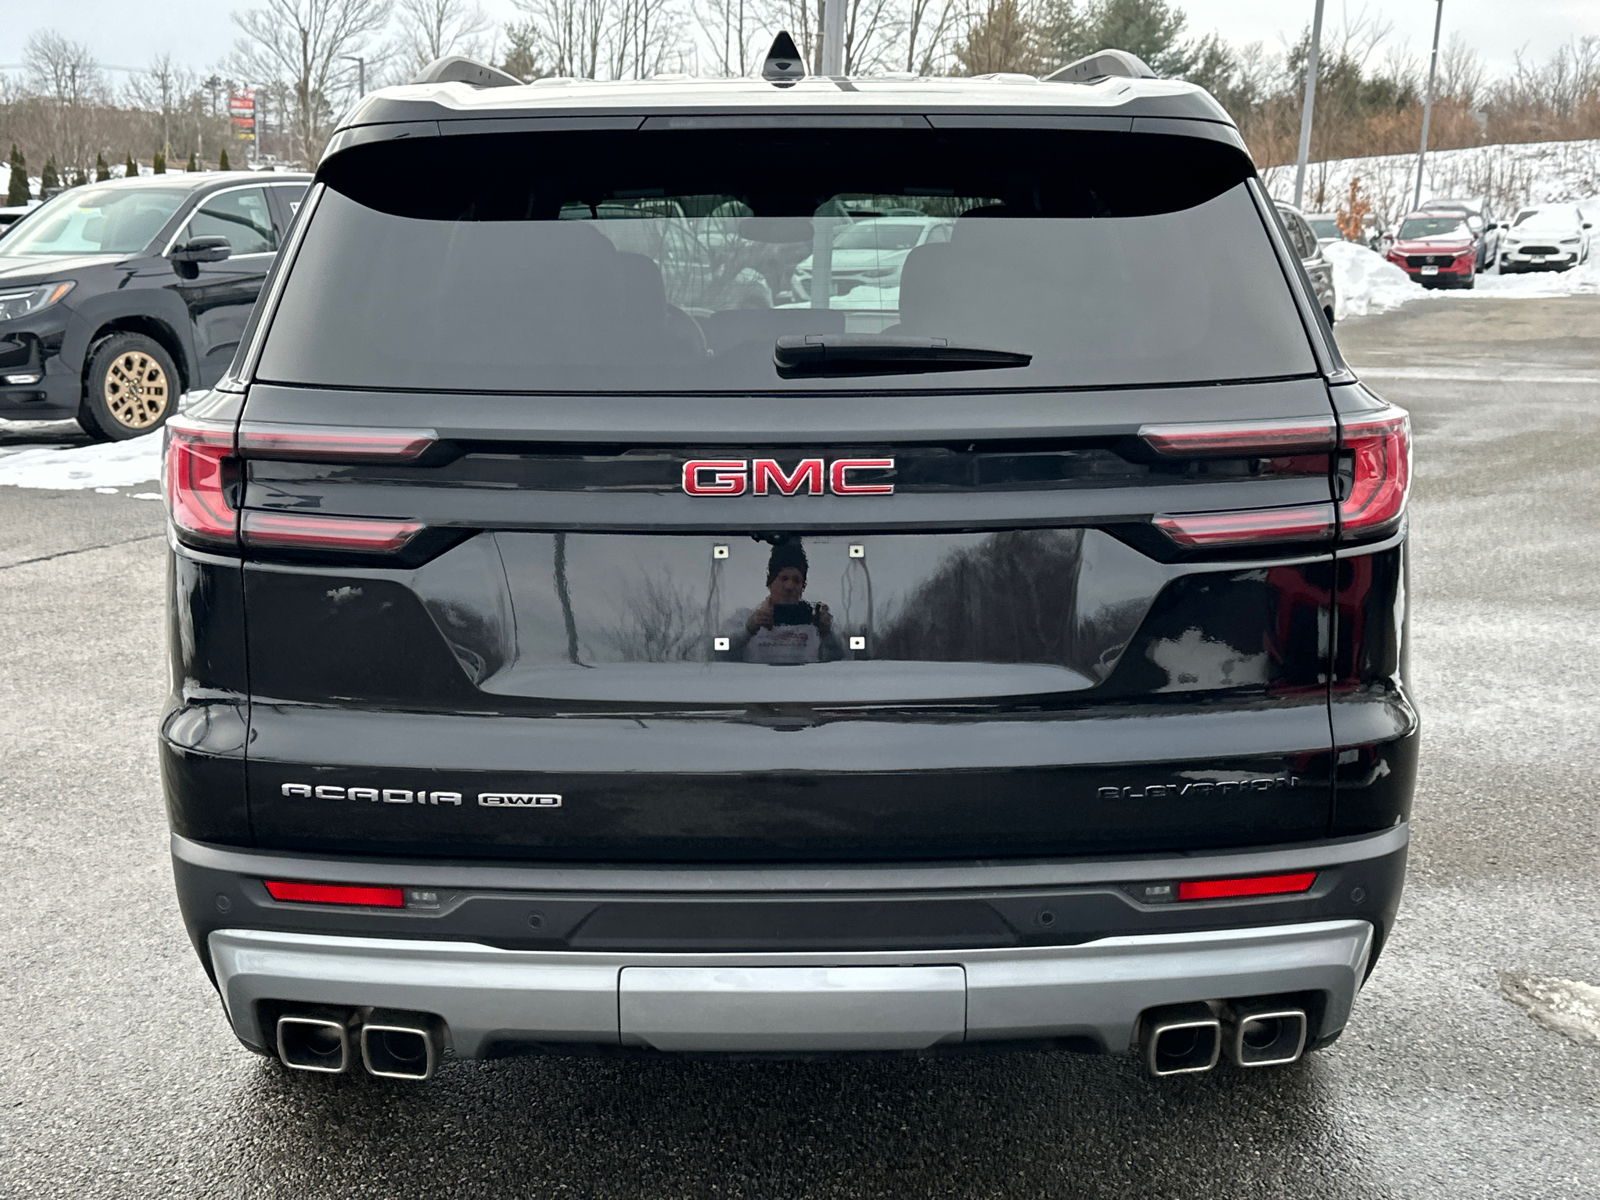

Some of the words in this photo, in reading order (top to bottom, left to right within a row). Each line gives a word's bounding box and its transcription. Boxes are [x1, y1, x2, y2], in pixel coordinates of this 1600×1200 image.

[682, 458, 895, 496] GMC
[281, 783, 462, 806] ACADIA
[479, 793, 561, 807] AWD
[1097, 776, 1300, 799] ELEVATION
